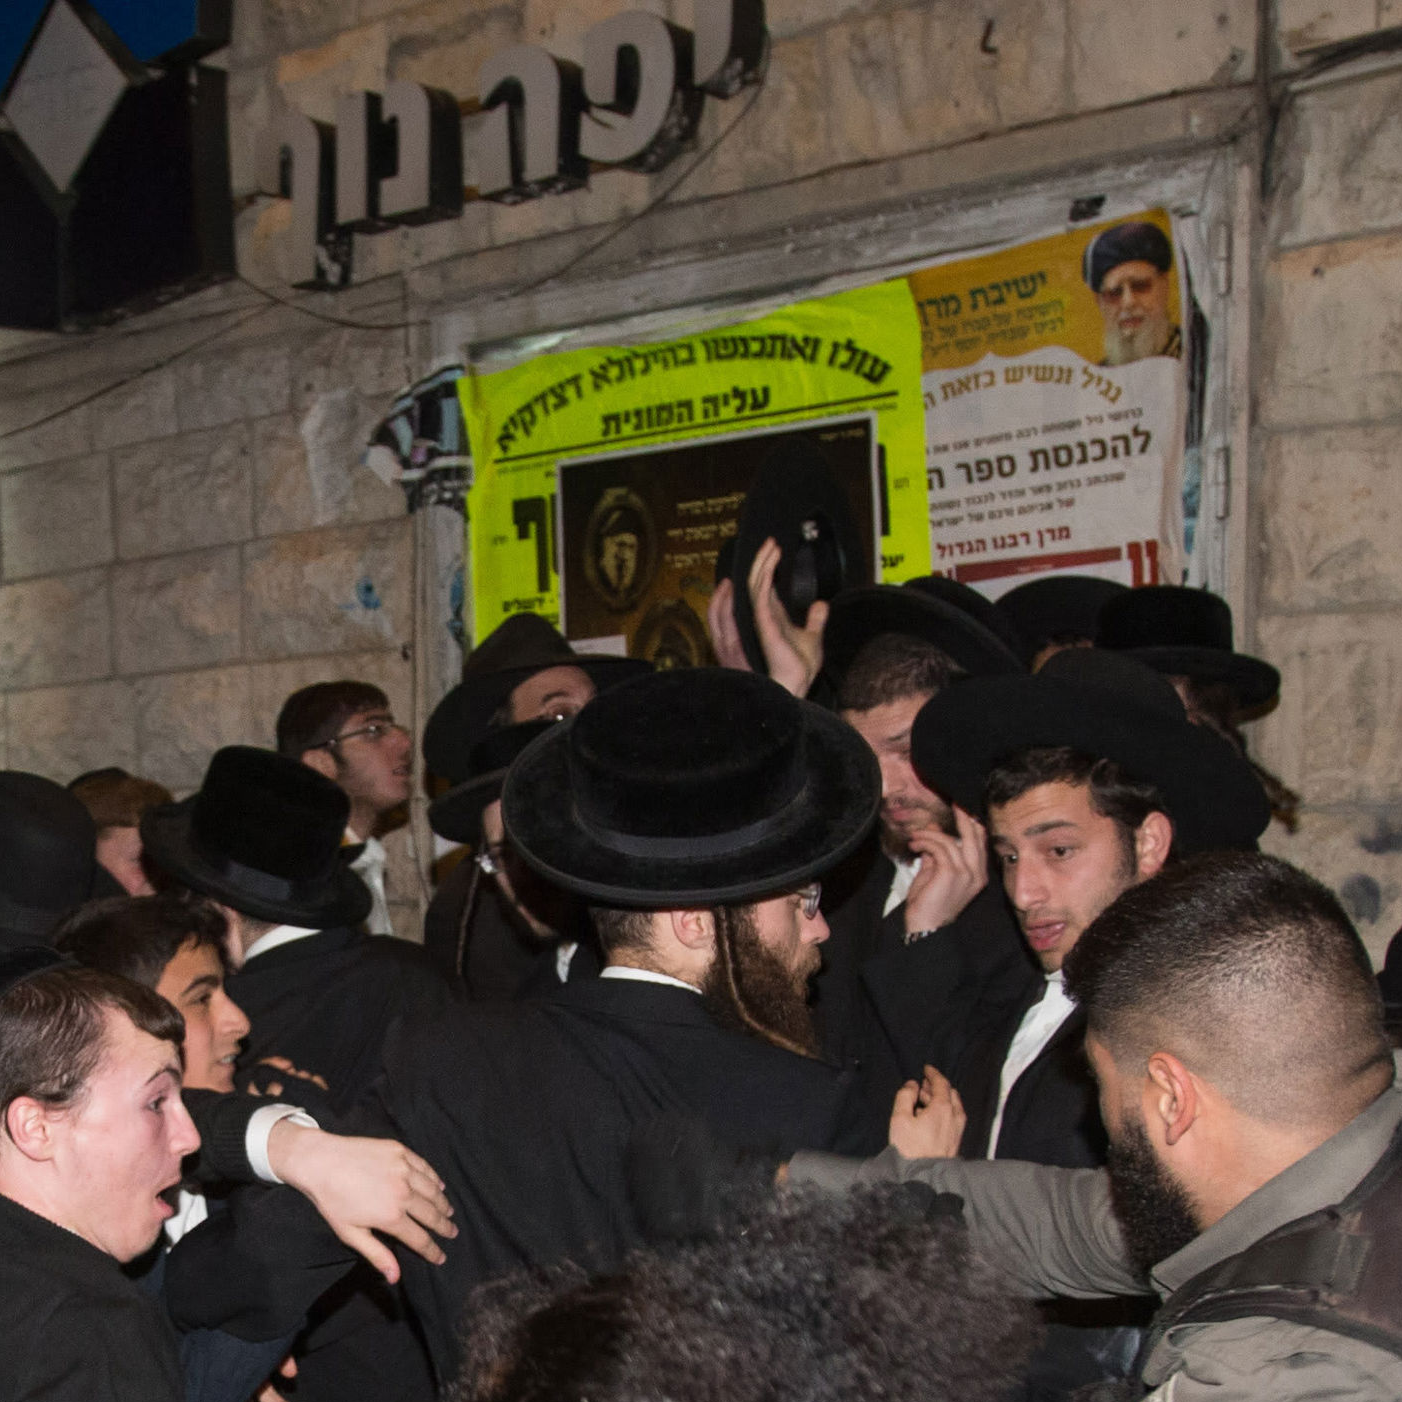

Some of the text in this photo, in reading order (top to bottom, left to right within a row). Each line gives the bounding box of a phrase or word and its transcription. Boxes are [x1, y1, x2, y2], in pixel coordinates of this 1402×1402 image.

[251, 82, 448, 289] נוף
[919, 270, 1047, 326] ישיבת מרן
[591, 341, 696, 393] בהילולא
[704, 333, 820, 364] ואתכנשו
[829, 338, 894, 386] עולו
[1003, 364, 1074, 386] ונשיש
[1081, 364, 1123, 405] נגיל
[601, 397, 696, 438] המונית
[702, 385, 772, 421] עליה
[955, 451, 1017, 484] ספר
[1029, 424, 1153, 475] להכנסת
[936, 525, 1072, 560] מרן רבנו הגדול
